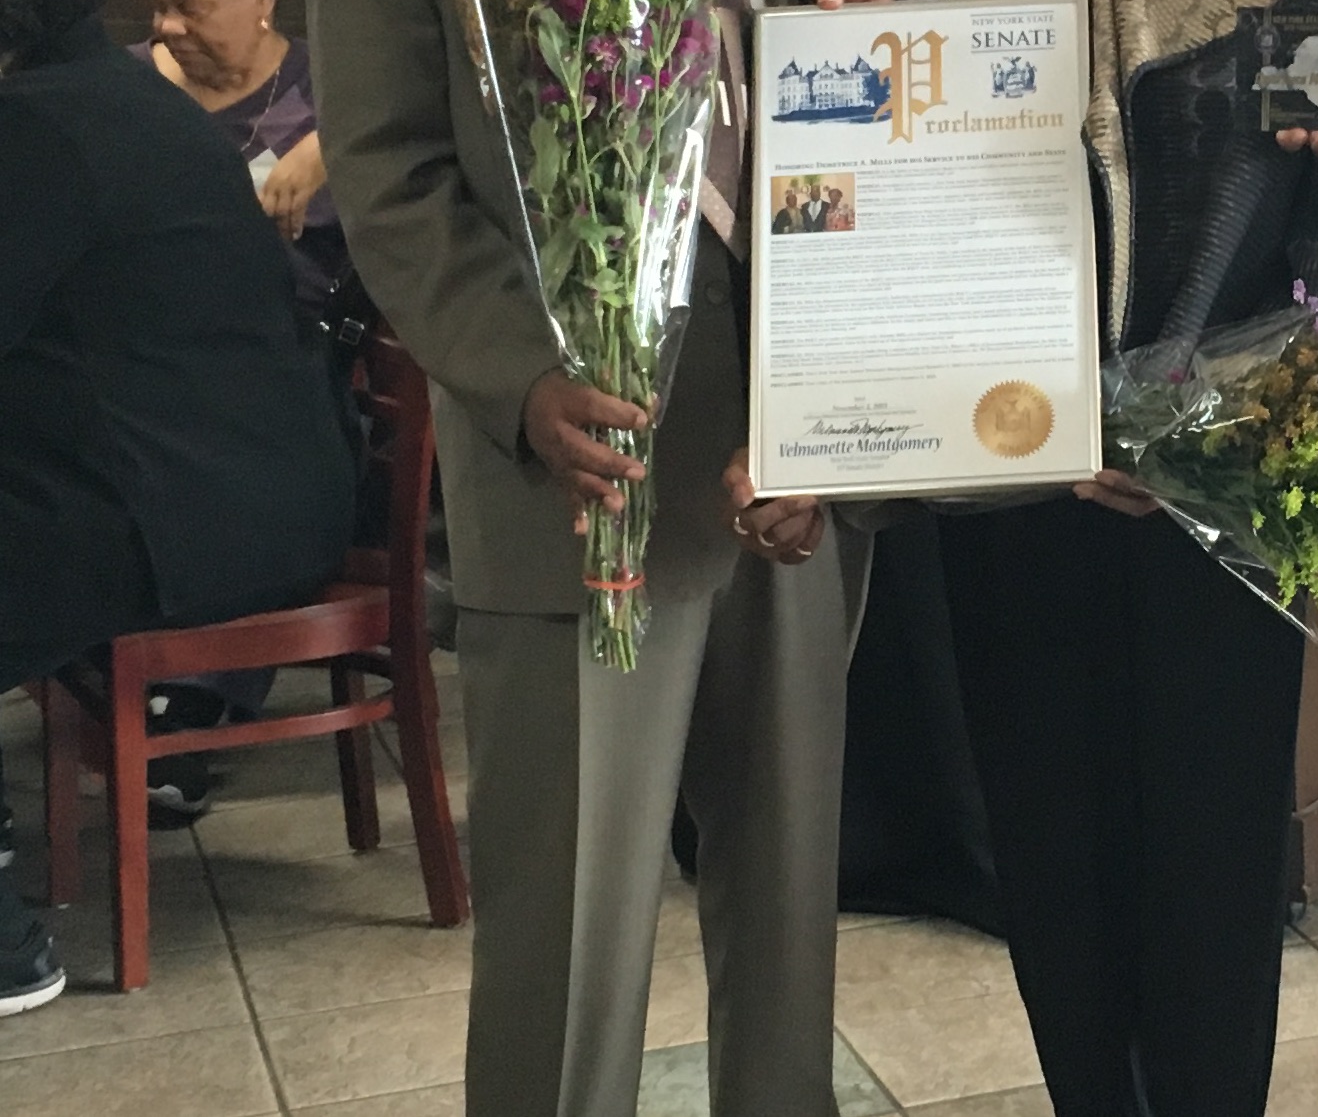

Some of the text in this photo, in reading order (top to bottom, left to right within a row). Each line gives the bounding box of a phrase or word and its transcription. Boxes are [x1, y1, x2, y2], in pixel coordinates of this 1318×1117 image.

[972, 14, 1054, 26] NEW YORK STATE
[971, 28, 1056, 49] SENATE
[779, 437, 943, 458] Velmanette Montgomery
